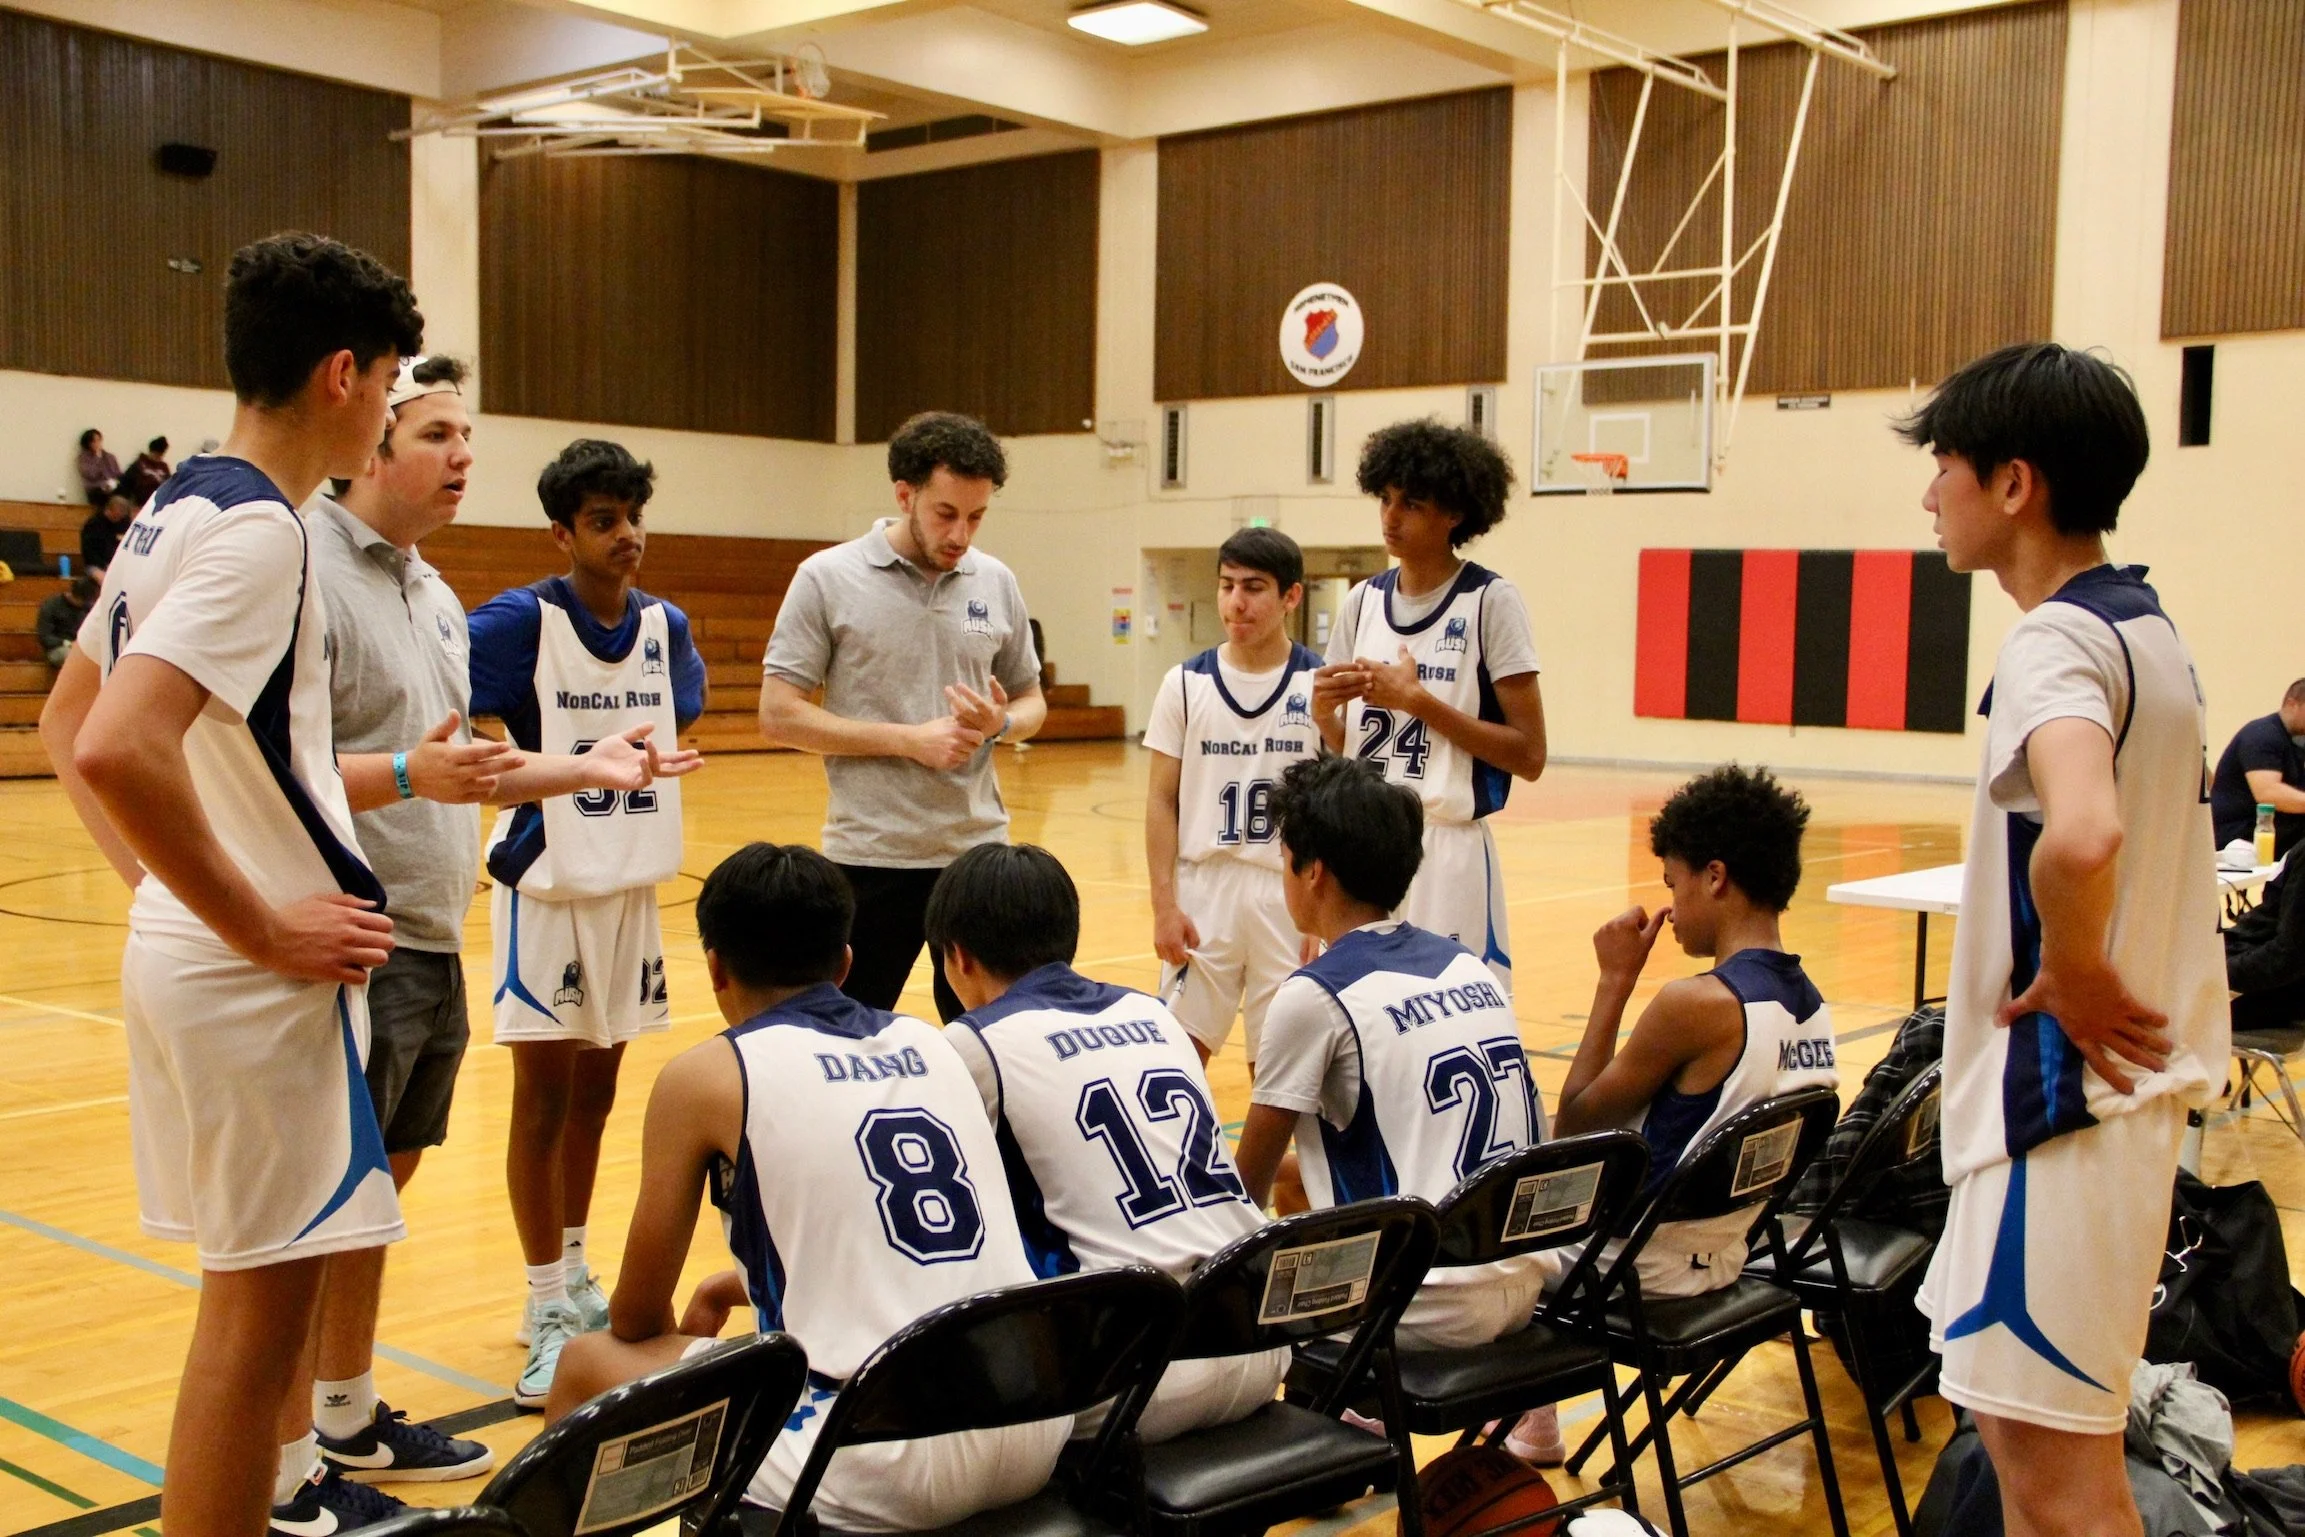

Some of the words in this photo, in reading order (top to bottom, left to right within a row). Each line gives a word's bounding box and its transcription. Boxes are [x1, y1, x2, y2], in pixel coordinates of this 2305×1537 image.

[1356, 705, 1431, 779] 24
[1044, 1020, 1168, 1062] DUQUE
[1383, 981, 1505, 1035] MIYOSHI
[813, 1044, 929, 1083] DANG
[1423, 1036, 1541, 1181] 27
[854, 1106, 985, 1266] 8
[1075, 1068, 1252, 1230] 12
